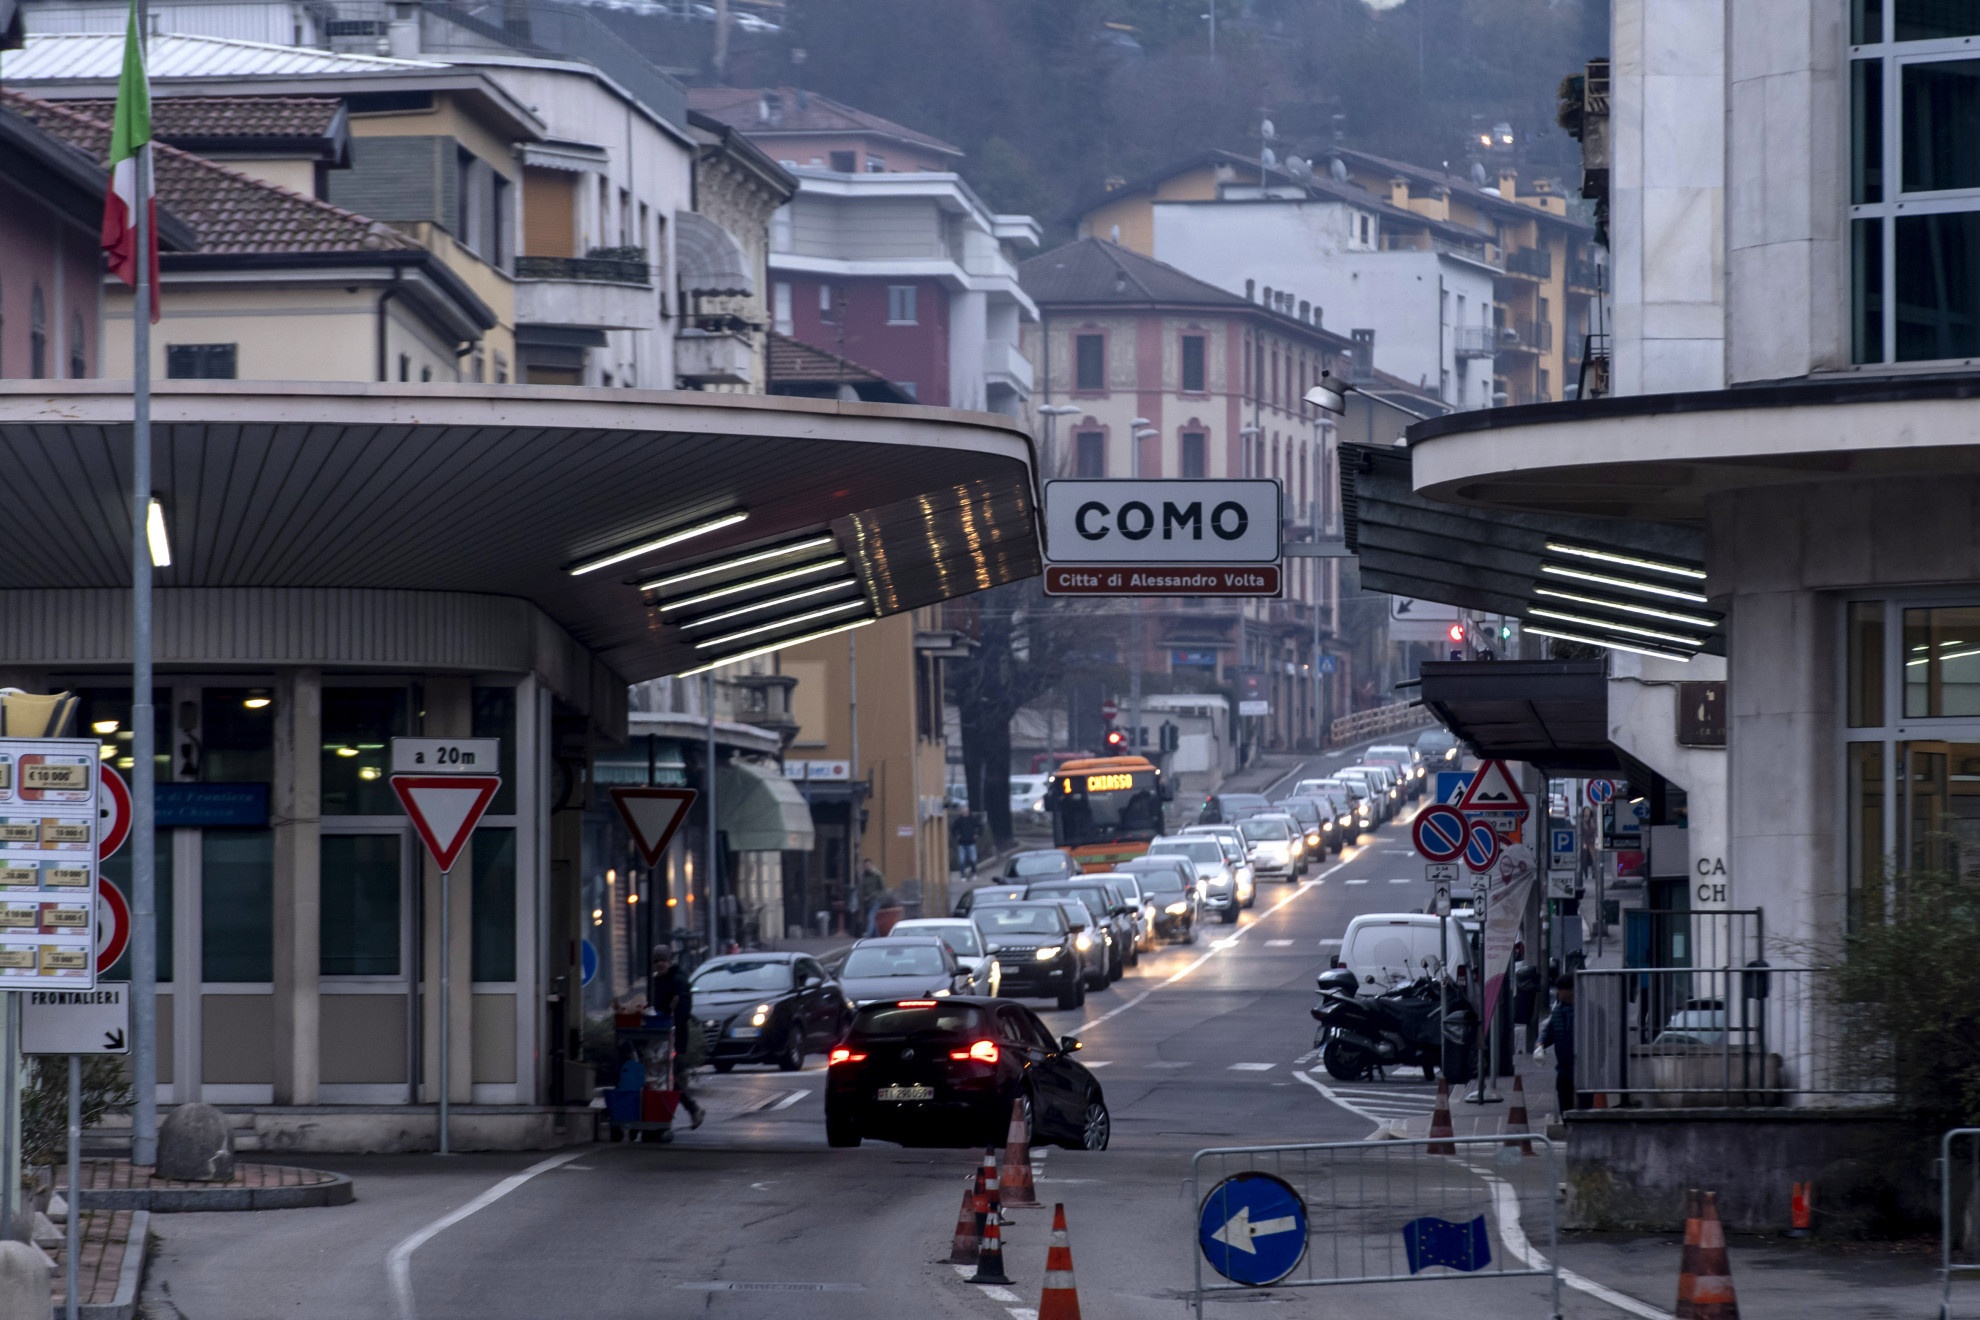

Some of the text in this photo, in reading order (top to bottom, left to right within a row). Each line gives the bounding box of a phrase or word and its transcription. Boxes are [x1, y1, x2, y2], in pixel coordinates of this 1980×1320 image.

[1075, 501, 1249, 540] COMO
[1107, 573, 1122, 587] di
[1130, 573, 1217, 587] Alessandro
[1224, 573, 1265, 587] Volta
[415, 752, 425, 764] a
[1063, 773, 1133, 794] 1 CHIASSO
[1697, 858, 1727, 875] CA
[1697, 884, 1727, 902] CH
[31, 991, 119, 1005] FRONTALIERI
